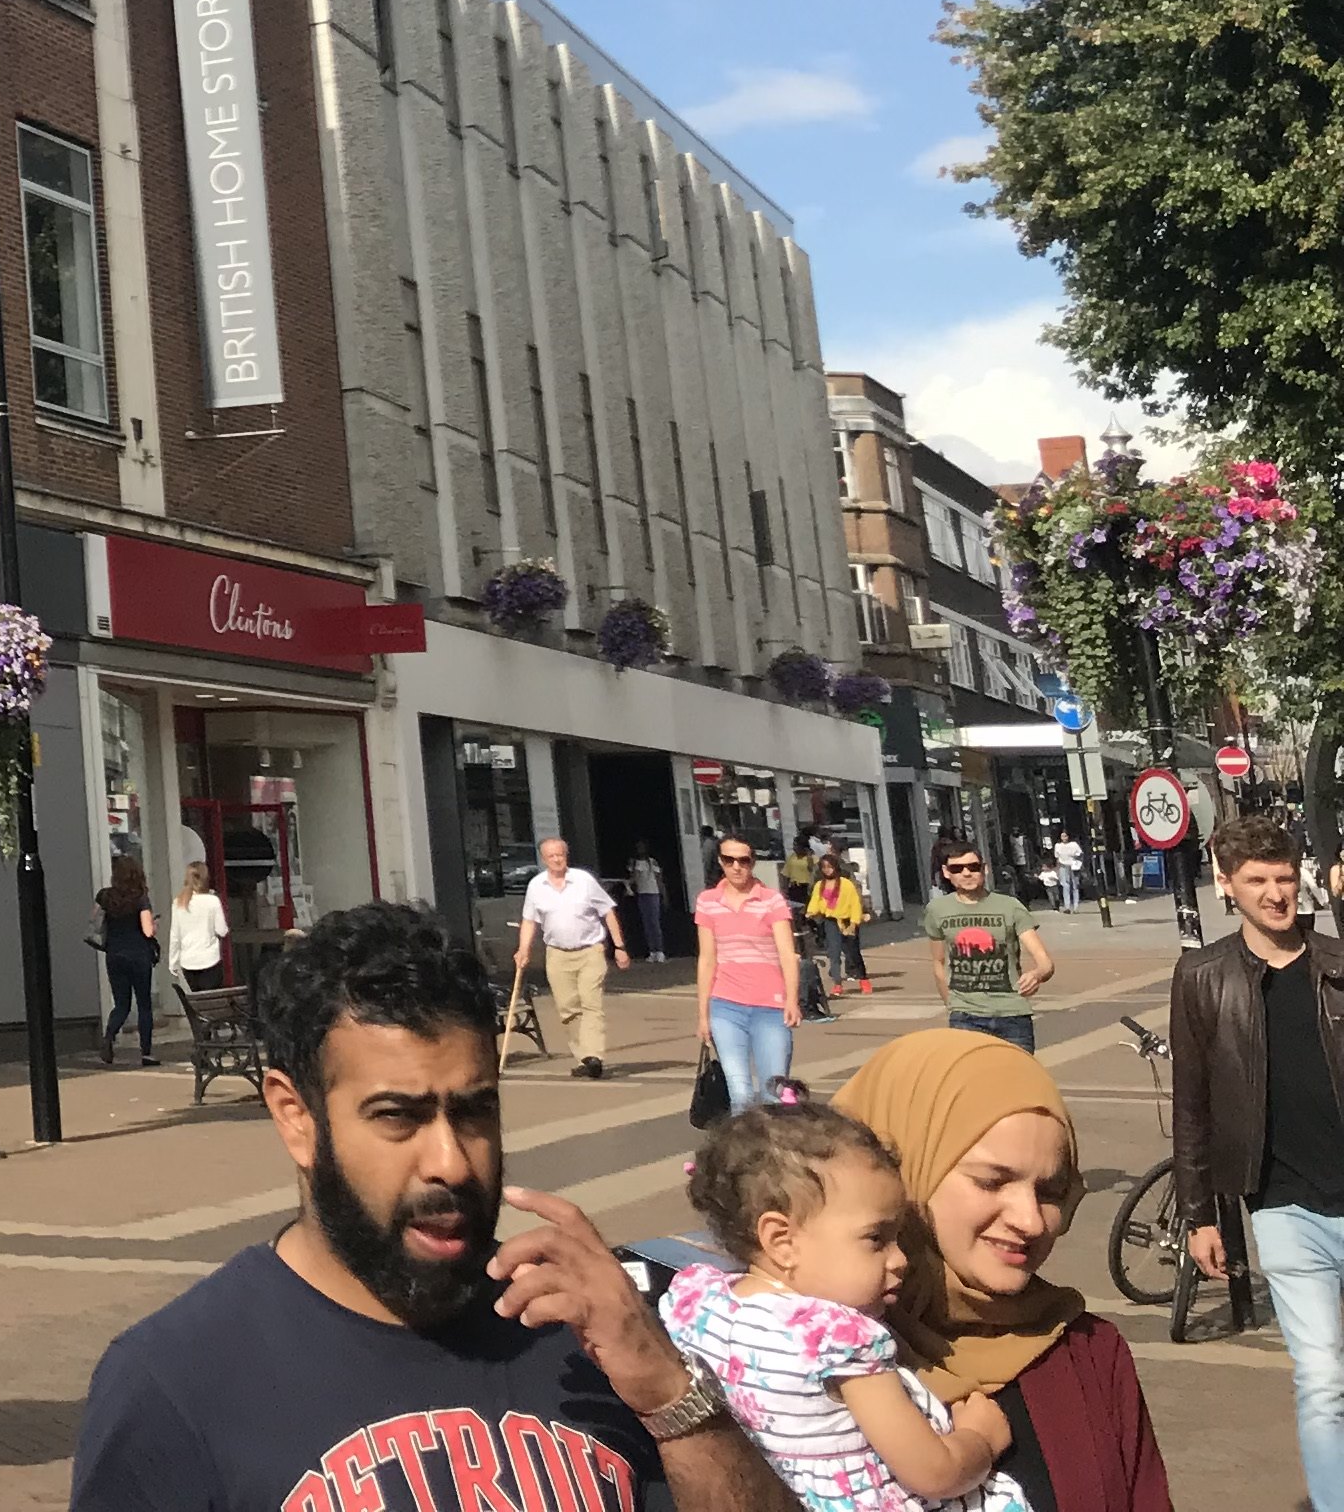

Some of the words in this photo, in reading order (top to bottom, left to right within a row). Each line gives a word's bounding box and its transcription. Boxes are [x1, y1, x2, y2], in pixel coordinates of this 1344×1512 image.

[205, 103, 248, 226] HOME
[216, 240, 259, 383] BRITISH
[209, 574, 294, 640] Clintons
[941, 917, 1003, 929] ORIGINALS
[953, 958, 1004, 974] TOKYO
